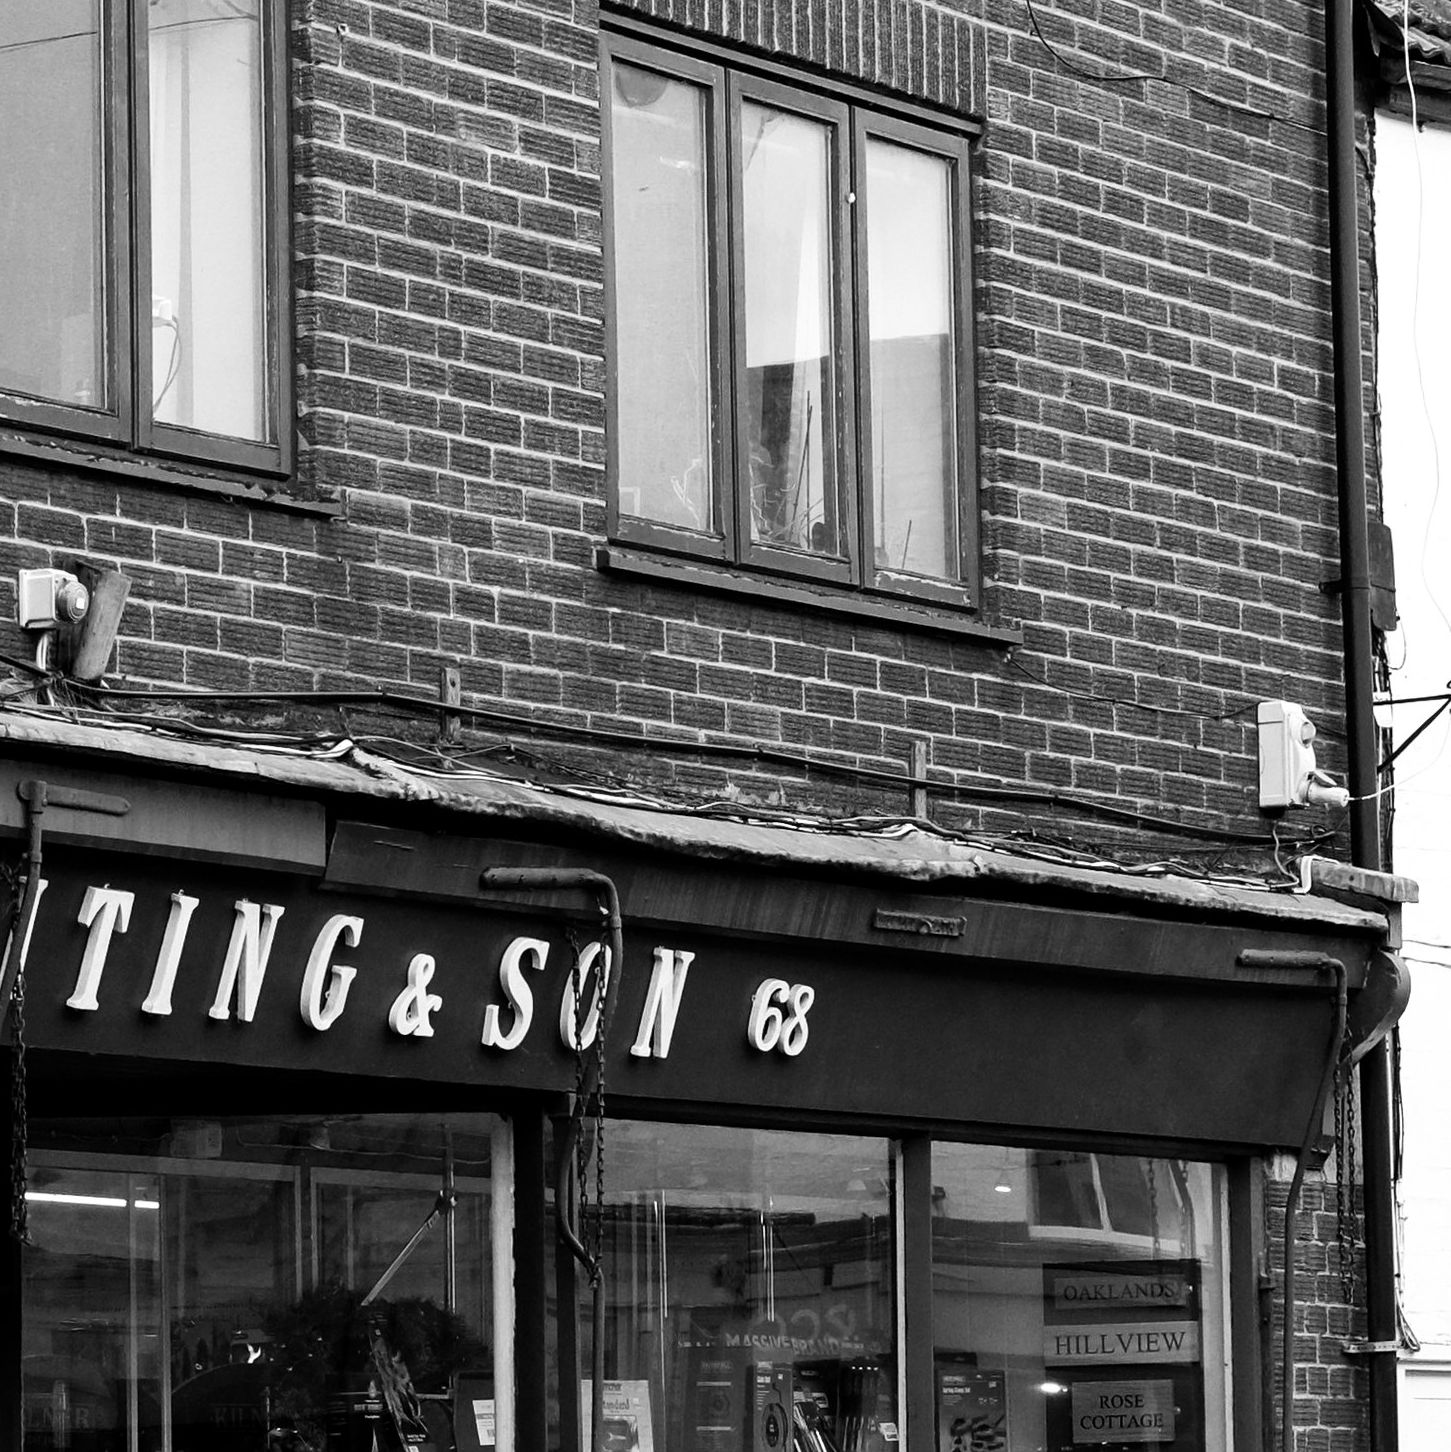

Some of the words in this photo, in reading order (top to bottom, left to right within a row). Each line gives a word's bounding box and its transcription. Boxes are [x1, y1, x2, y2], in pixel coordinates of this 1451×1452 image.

[388, 953, 444, 1037] &
[480, 936, 695, 1058] SON
[747, 977, 816, 1057] 68
[1063, 1282, 1176, 1301] OAKLANDS
[1054, 1331, 1186, 1356] HILLVIEW
[1099, 1394, 1146, 1410] ROSE
[1079, 1412, 1165, 1431] COTTAGE
